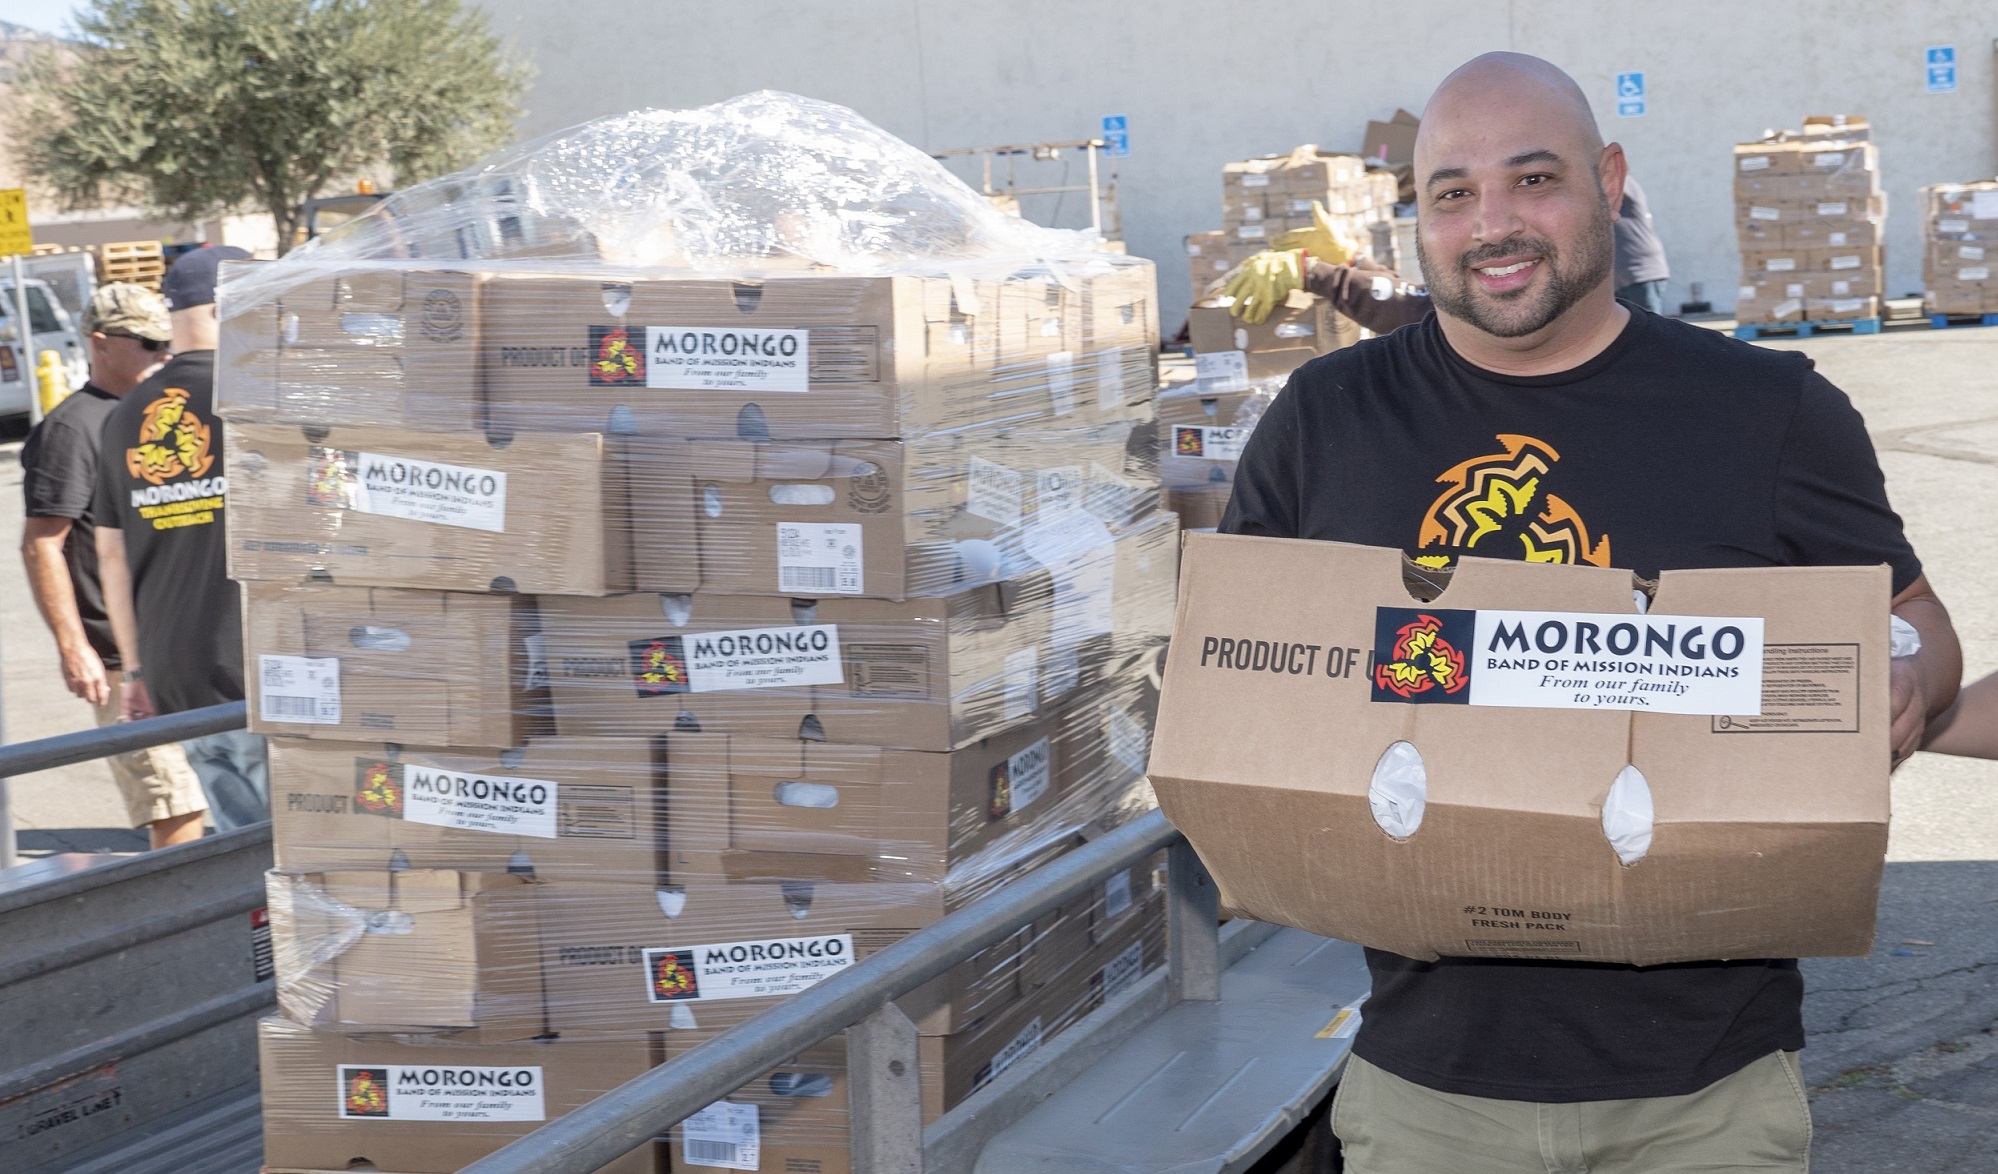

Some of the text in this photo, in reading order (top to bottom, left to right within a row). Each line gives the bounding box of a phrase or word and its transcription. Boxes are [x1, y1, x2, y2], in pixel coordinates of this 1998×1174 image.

[656, 332, 797, 356] MORONGO
[501, 347, 566, 367] PRODUCT
[655, 357, 684, 366] BAND
[686, 358, 699, 366] OF
[702, 359, 748, 367] MISSION
[683, 368, 712, 376] From
[734, 370, 768, 379] family
[366, 462, 497, 497] MORONGO
[131, 476, 229, 507] MORONGO
[694, 630, 828, 659] MORONGO
[1488, 619, 1745, 660] MORONGO
[695, 655, 829, 670] BAND OF MISSION INDIANS
[1201, 636, 1321, 675] PRODUCT
[1326, 647, 1360, 678] OF
[1487, 658, 1739, 678] BAND OF MISSION INDIANS
[1538, 675, 1689, 696] From our family
[1574, 693, 1650, 706] to yours.
[413, 772, 546, 805] MORONGO
[288, 793, 349, 814] PRODUCT
[411, 793, 438, 803] BAND
[456, 800, 498, 812] MISSION
[501, 805, 545, 815] INDIANS
[1464, 905, 1572, 921] #2 TOM BODY
[1472, 919, 1565, 931] FRESH PACK
[705, 938, 842, 965] MORONGO
[704, 958, 847, 976] BAND OF MISSION INDIANS
[730, 977, 763, 985] From
[787, 973, 825, 983] family
[398, 1069, 532, 1087] MORONGO
[443, 1089, 487, 1097] MISSION
[489, 1089, 536, 1097] INDIANS
[420, 1100, 451, 1108] From
[475, 1101, 513, 1110] family
